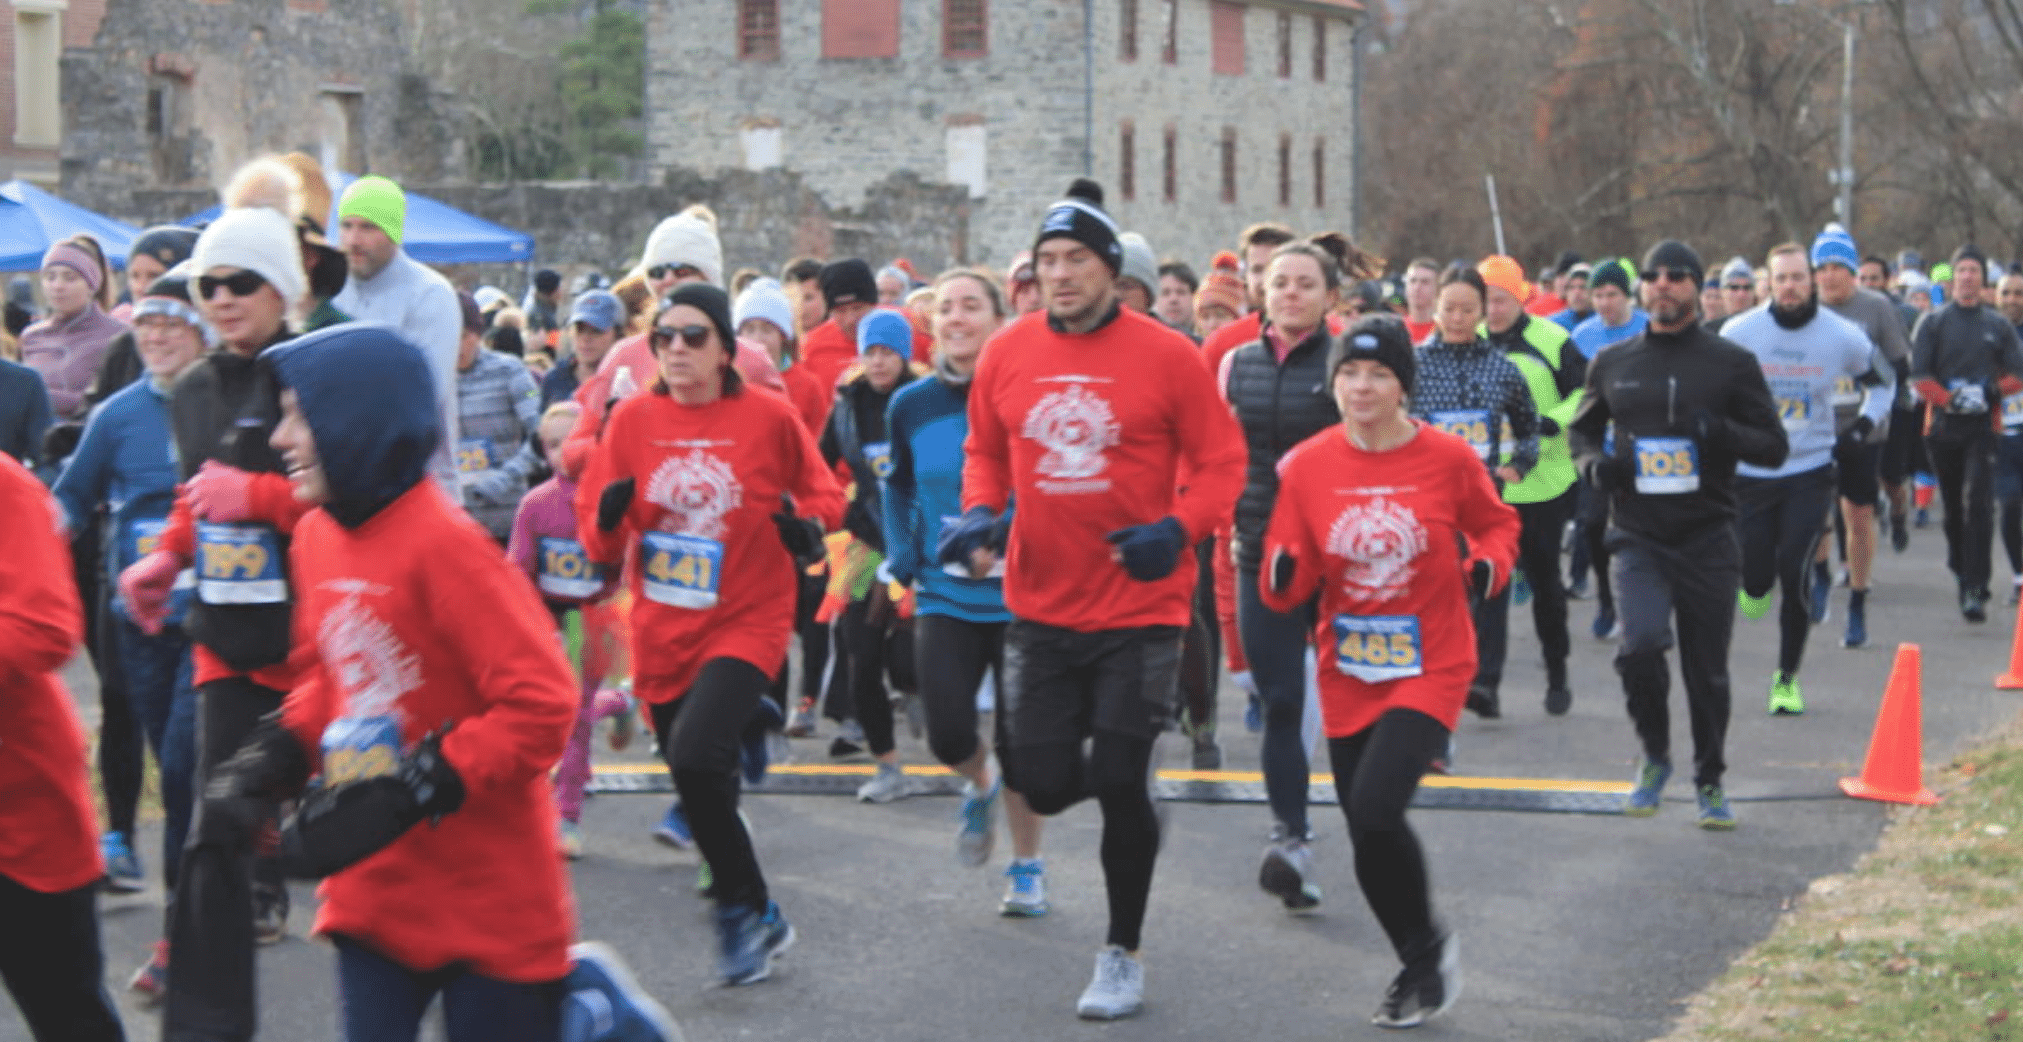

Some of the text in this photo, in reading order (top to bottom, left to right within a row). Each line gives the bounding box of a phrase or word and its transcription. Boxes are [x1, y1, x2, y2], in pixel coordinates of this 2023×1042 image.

[1639, 451, 1693, 477] 105
[647, 551, 712, 590] 441
[1338, 632, 1417, 667] 485
